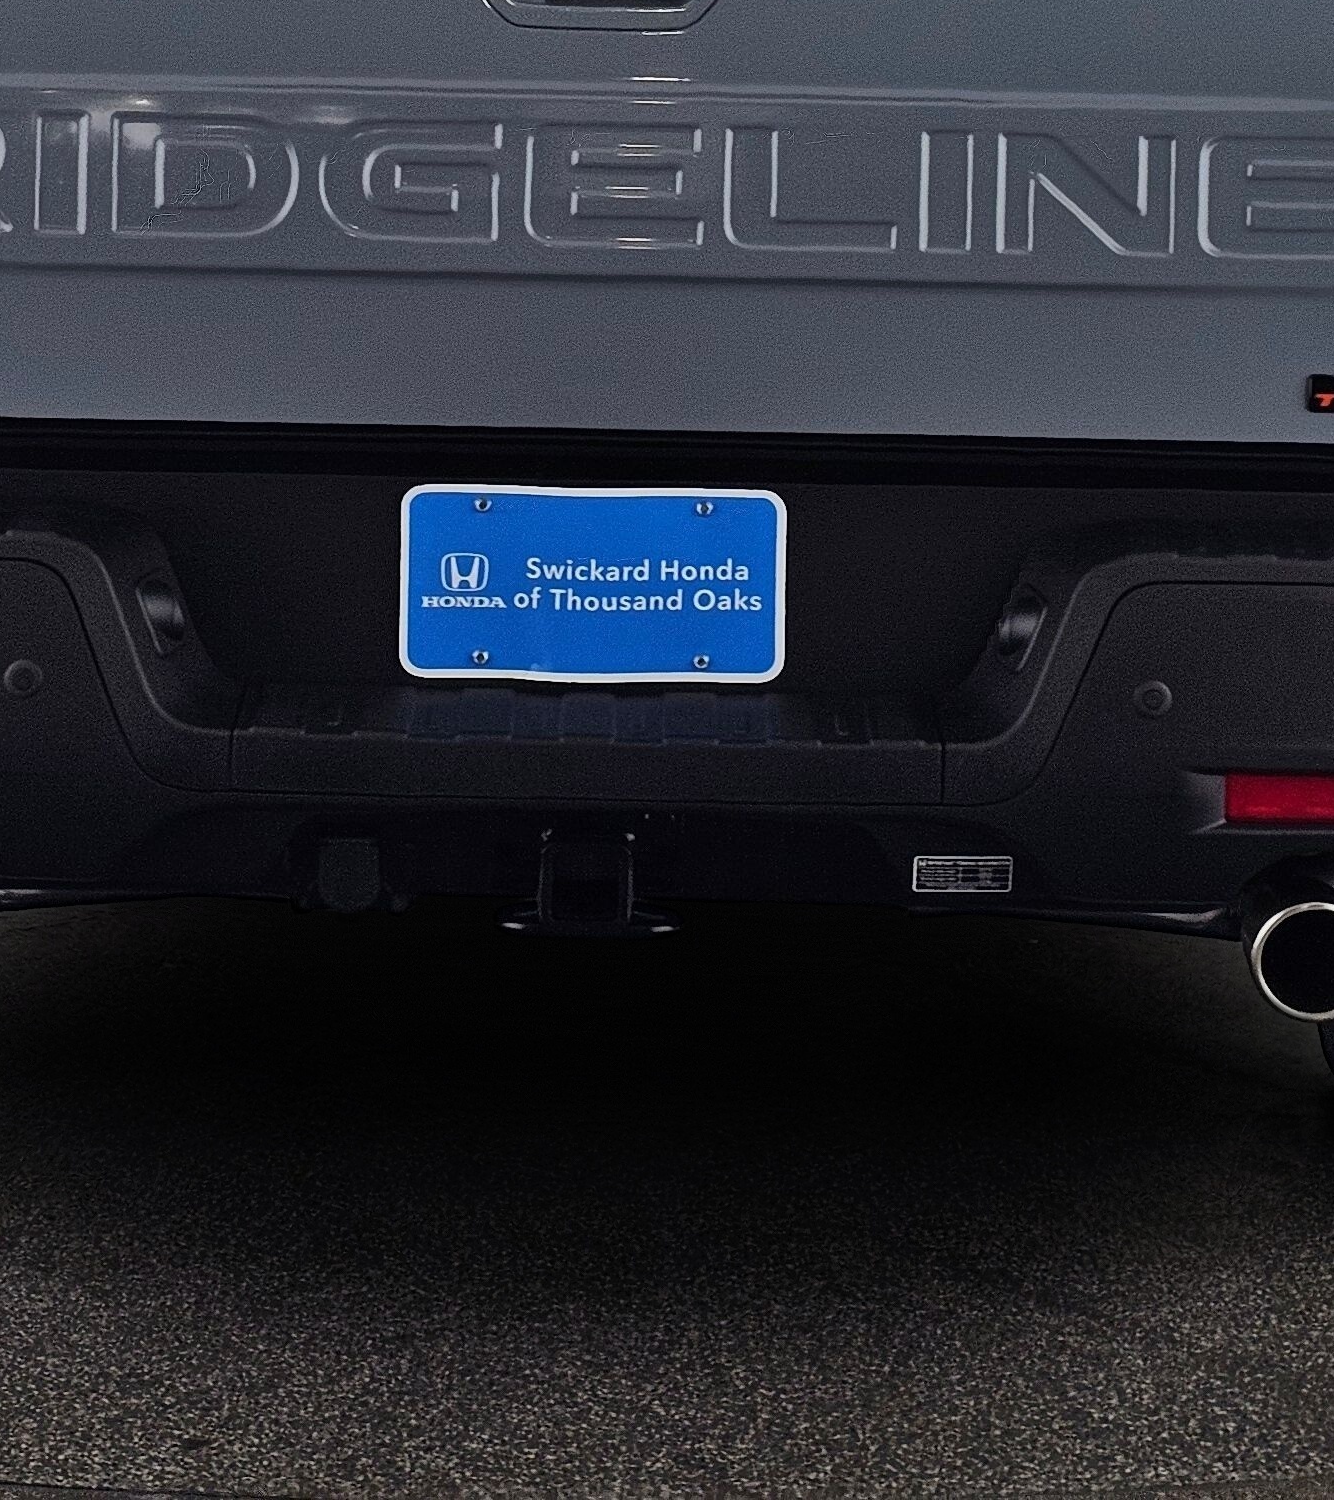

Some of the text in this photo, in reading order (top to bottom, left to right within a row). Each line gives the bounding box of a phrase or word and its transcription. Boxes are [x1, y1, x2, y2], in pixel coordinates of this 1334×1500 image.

[525, 557, 749, 582] Swickard Honda
[421, 595, 507, 609] HONDA
[513, 587, 763, 612] of Thousand Oaks
